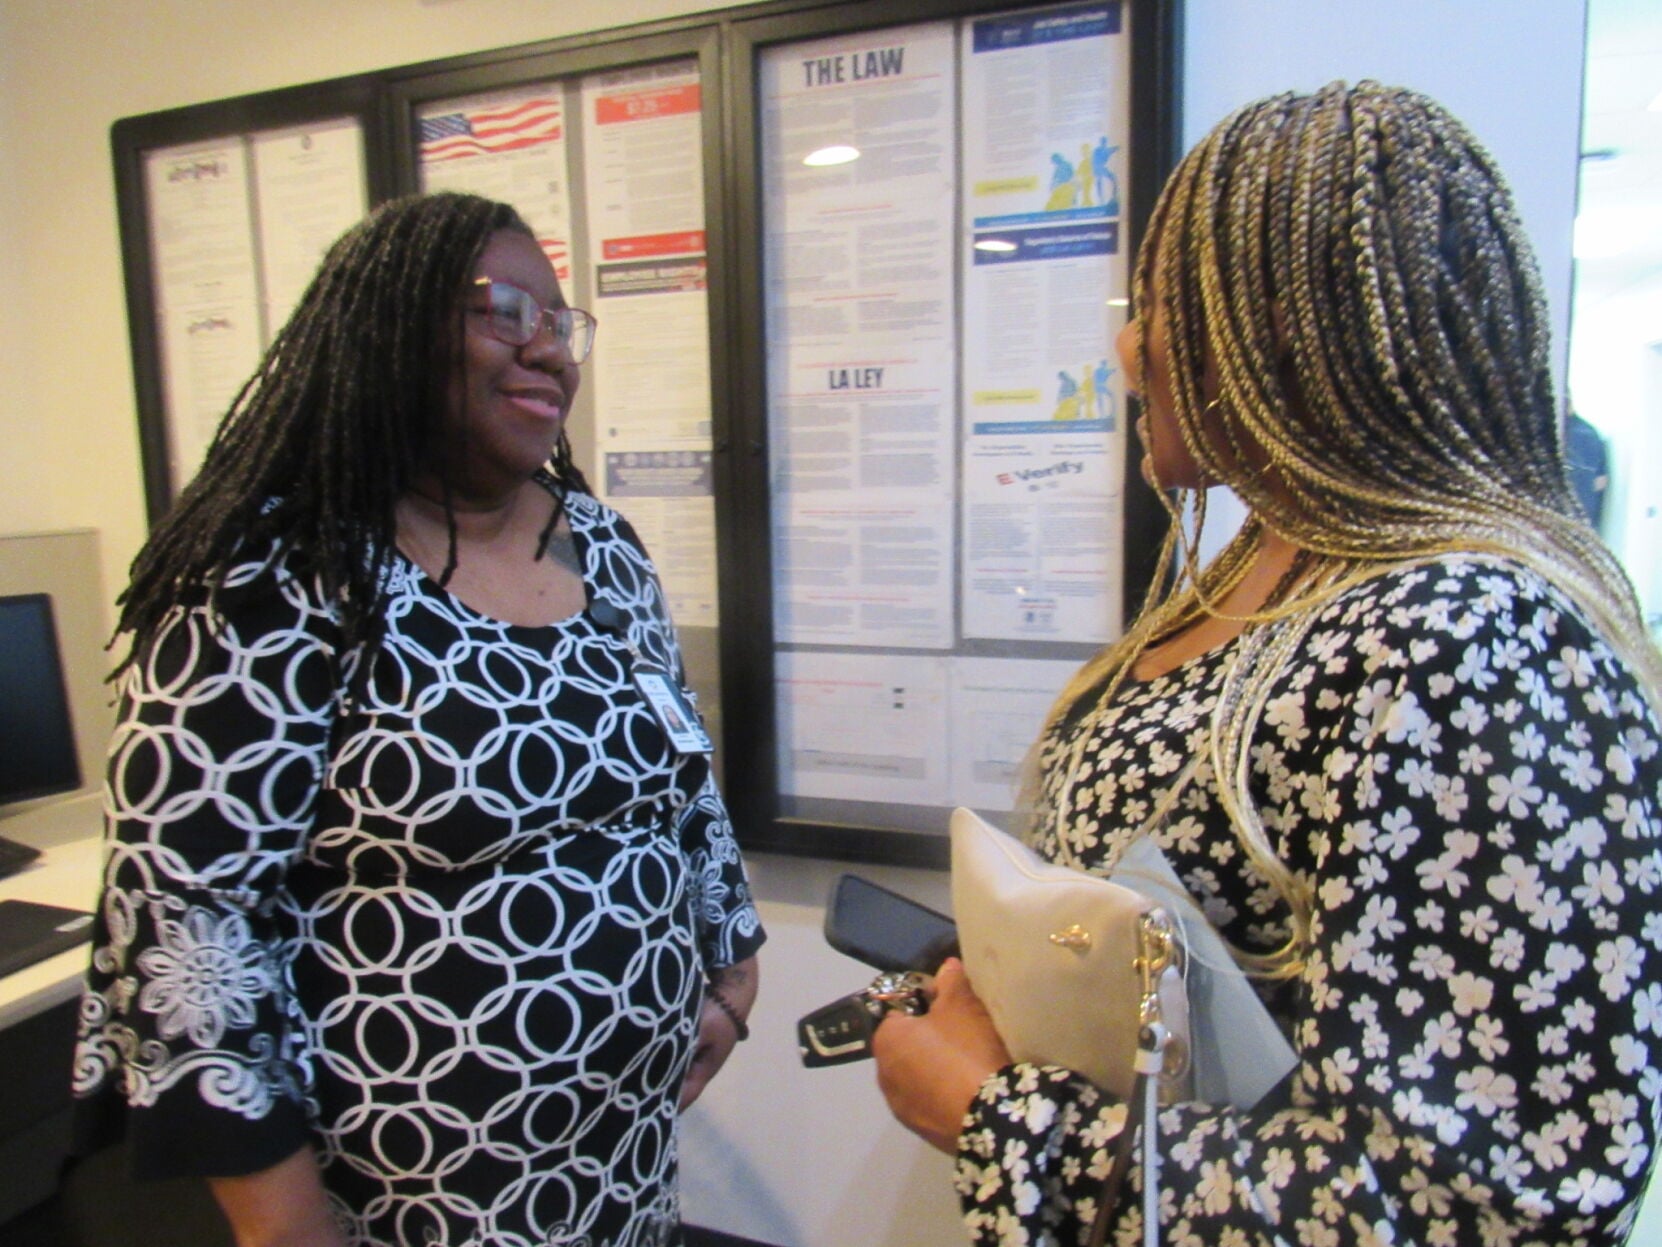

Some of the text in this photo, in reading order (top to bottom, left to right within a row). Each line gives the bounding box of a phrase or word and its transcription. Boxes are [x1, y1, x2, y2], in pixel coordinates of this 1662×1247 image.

[803, 47, 904, 87] THE LAW
[829, 368, 884, 389] LA LEY
